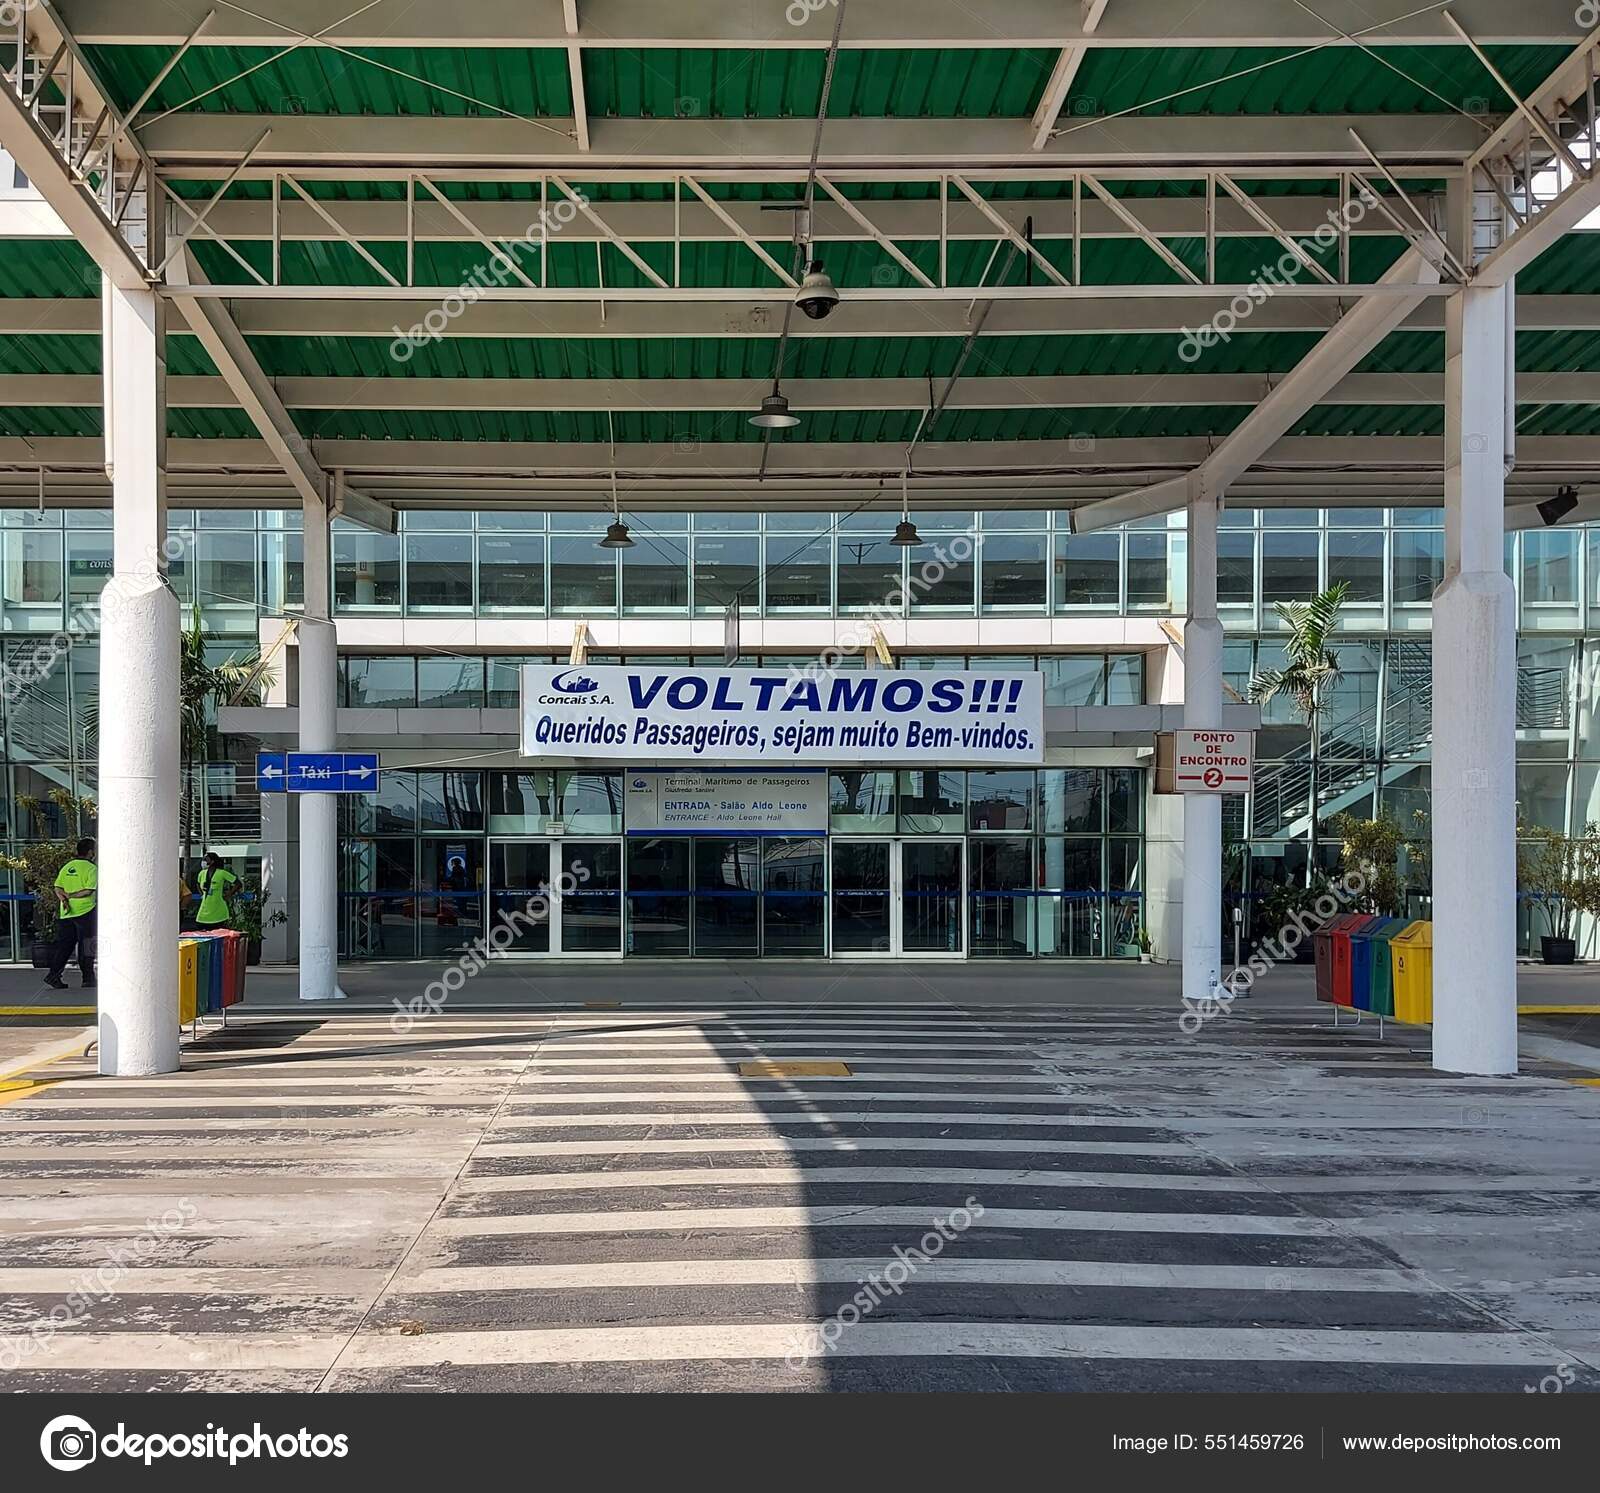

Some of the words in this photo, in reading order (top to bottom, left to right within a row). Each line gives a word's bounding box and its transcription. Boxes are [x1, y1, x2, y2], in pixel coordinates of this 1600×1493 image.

[538, 694, 587, 705] Concais
[590, 694, 615, 705] S.A.
[627, 675, 1024, 713] VOLTAMOS!!!
[535, 714, 627, 745] Queridos
[632, 716, 766, 753] Passageiros,
[772, 719, 835, 753] sejam
[839, 719, 899, 748] muito
[905, 720, 1035, 750] Bem-vindos.
[1193, 733, 1235, 743] PONTO
[1206, 745, 1222, 754] DE
[1180, 756, 1247, 766] ENCONTRO
[299, 765, 331, 779] Táxi
[664, 777, 701, 786] Terminal
[762, 777, 810, 788] Passageiros
[1207, 770, 1220, 786] 2
[664, 801, 711, 810] ENTRADA
[720, 801, 746, 810] Salão
[751, 801, 773, 810] Aldo
[779, 801, 807, 810] Leone
